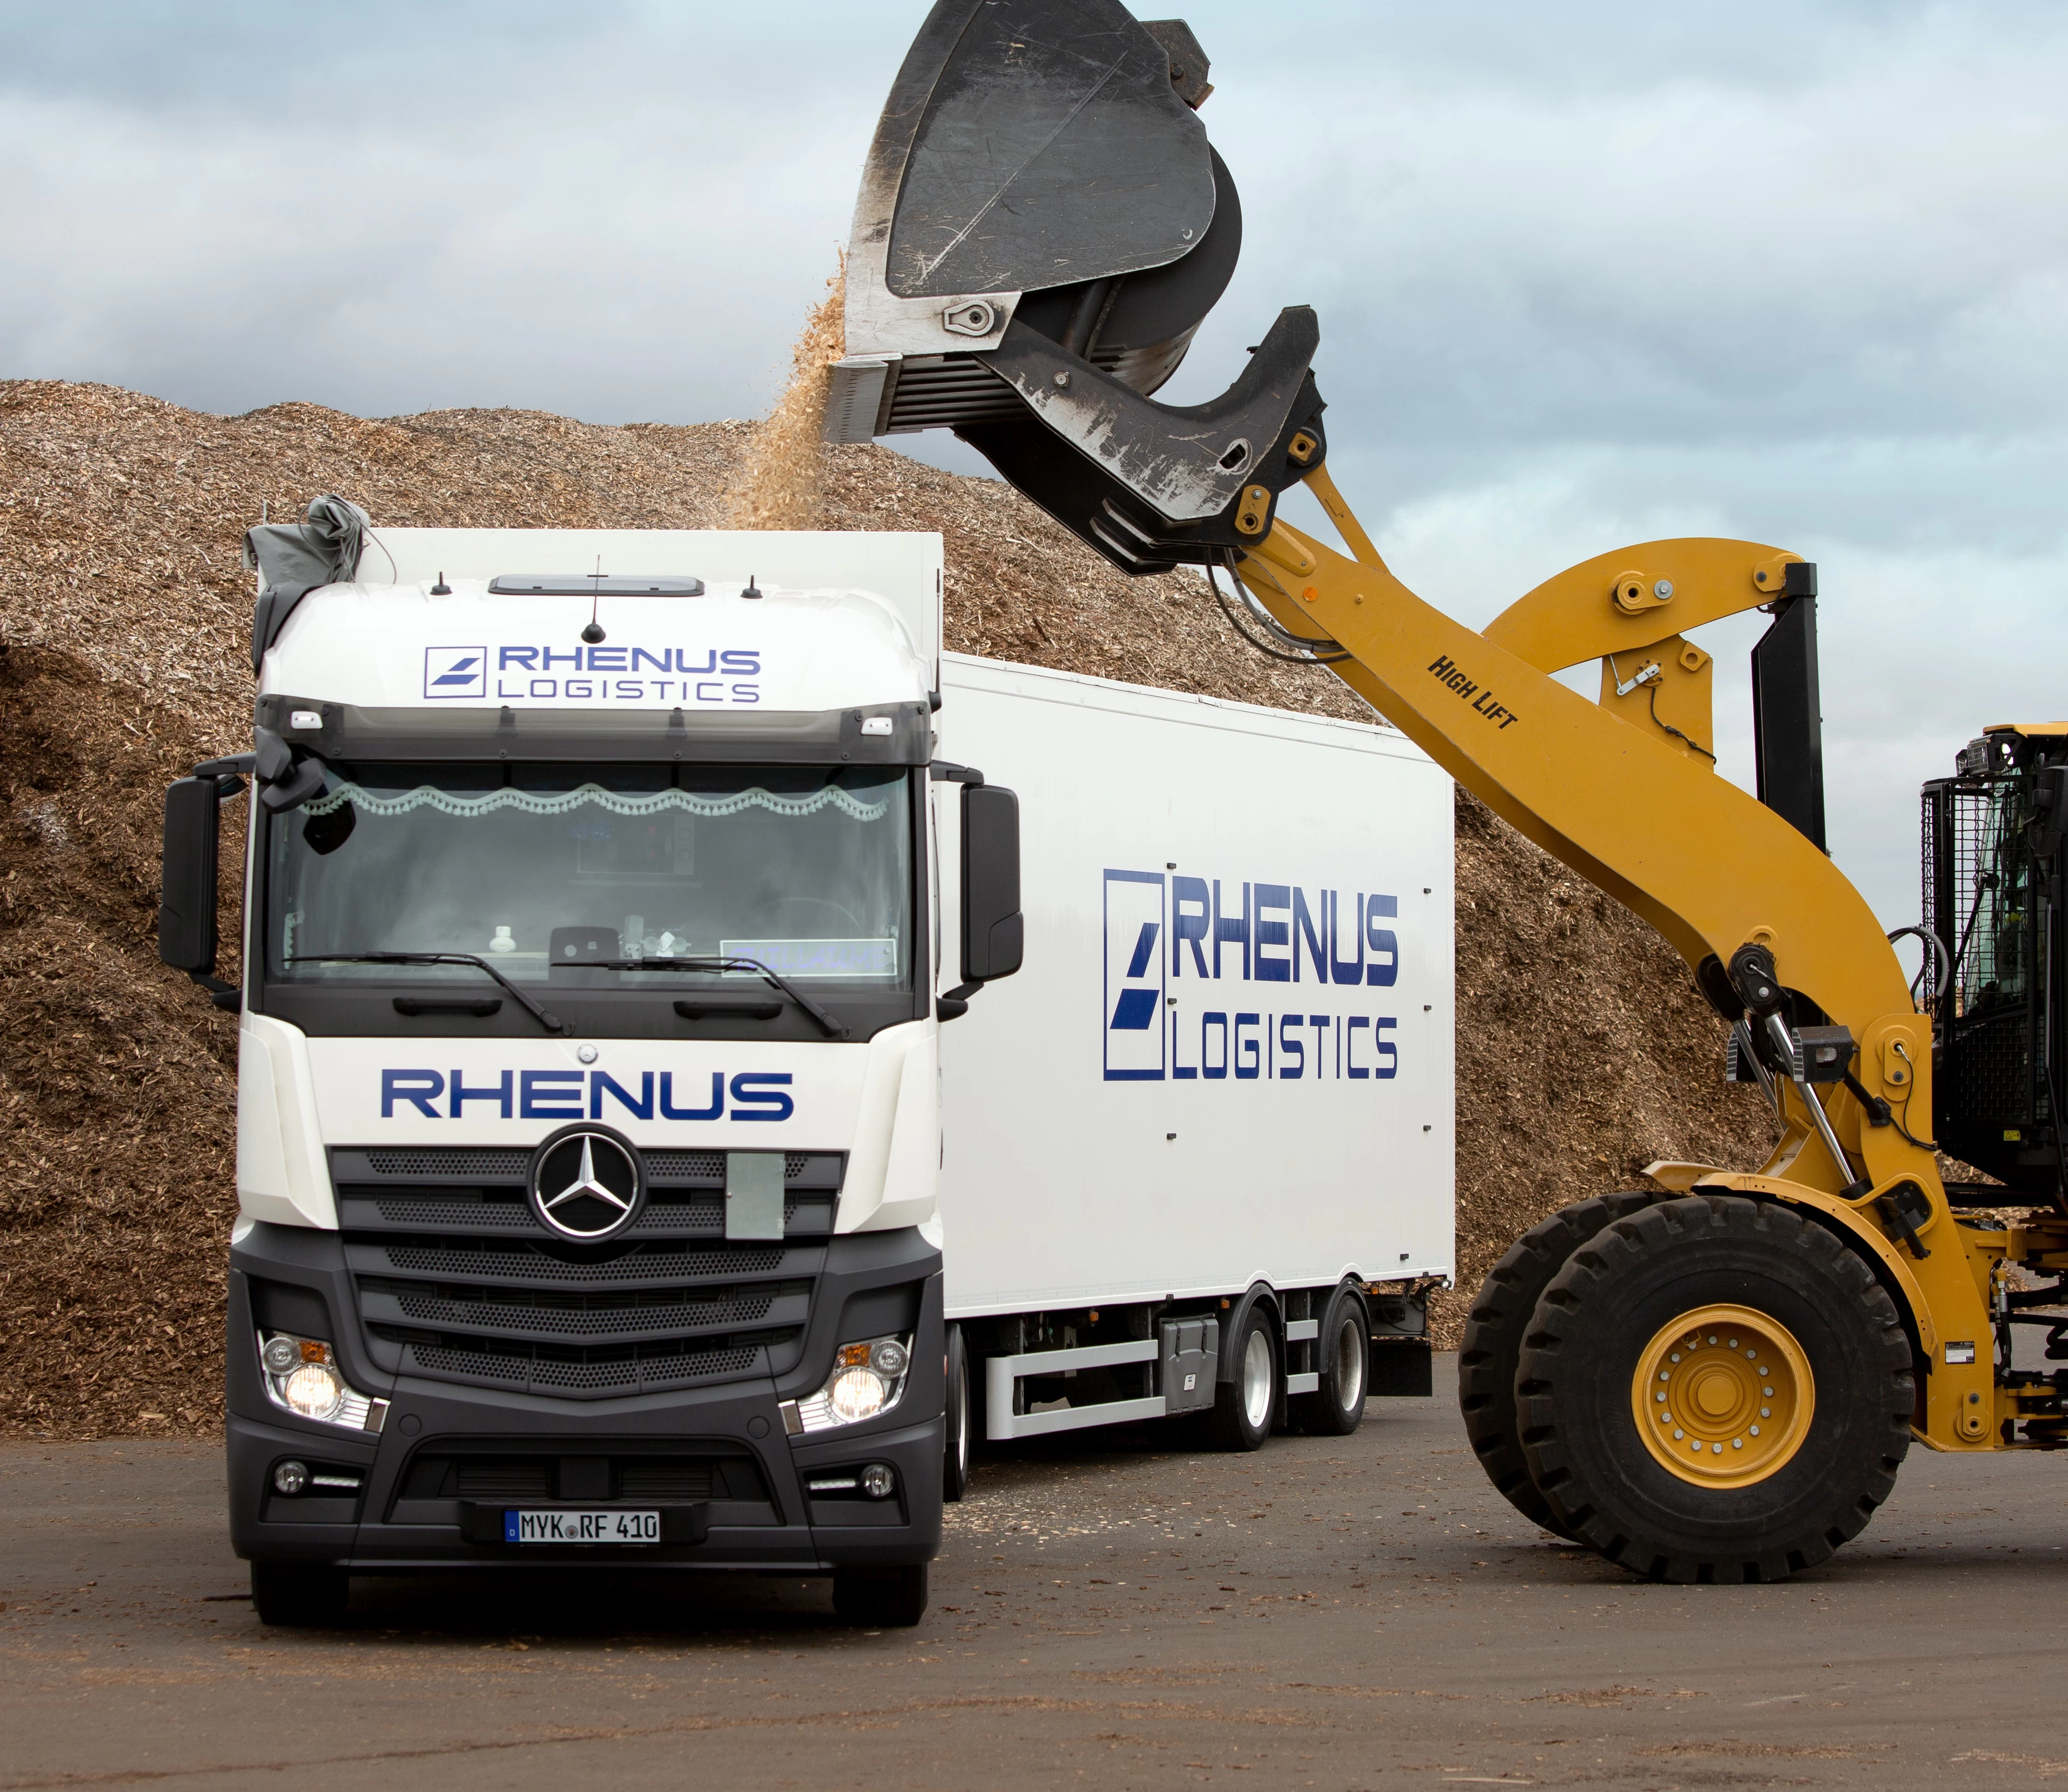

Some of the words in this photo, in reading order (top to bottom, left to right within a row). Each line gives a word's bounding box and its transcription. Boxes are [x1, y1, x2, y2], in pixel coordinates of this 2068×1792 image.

[498, 645, 761, 675] RHENUS
[498, 679, 760, 703] LOGISTICS
[1427, 655, 1479, 699] HIGH
[1472, 690, 1519, 730] LIFT
[1172, 875, 1399, 987] RHENUS
[1172, 1010, 1398, 1079] LOGISTICS
[381, 1069, 795, 1122] RHENUS
[509, 1528, 515, 1537] D
[521, 1515, 564, 1539] MYK
[580, 1515, 608, 1539] RF
[616, 1515, 658, 1539] 410
